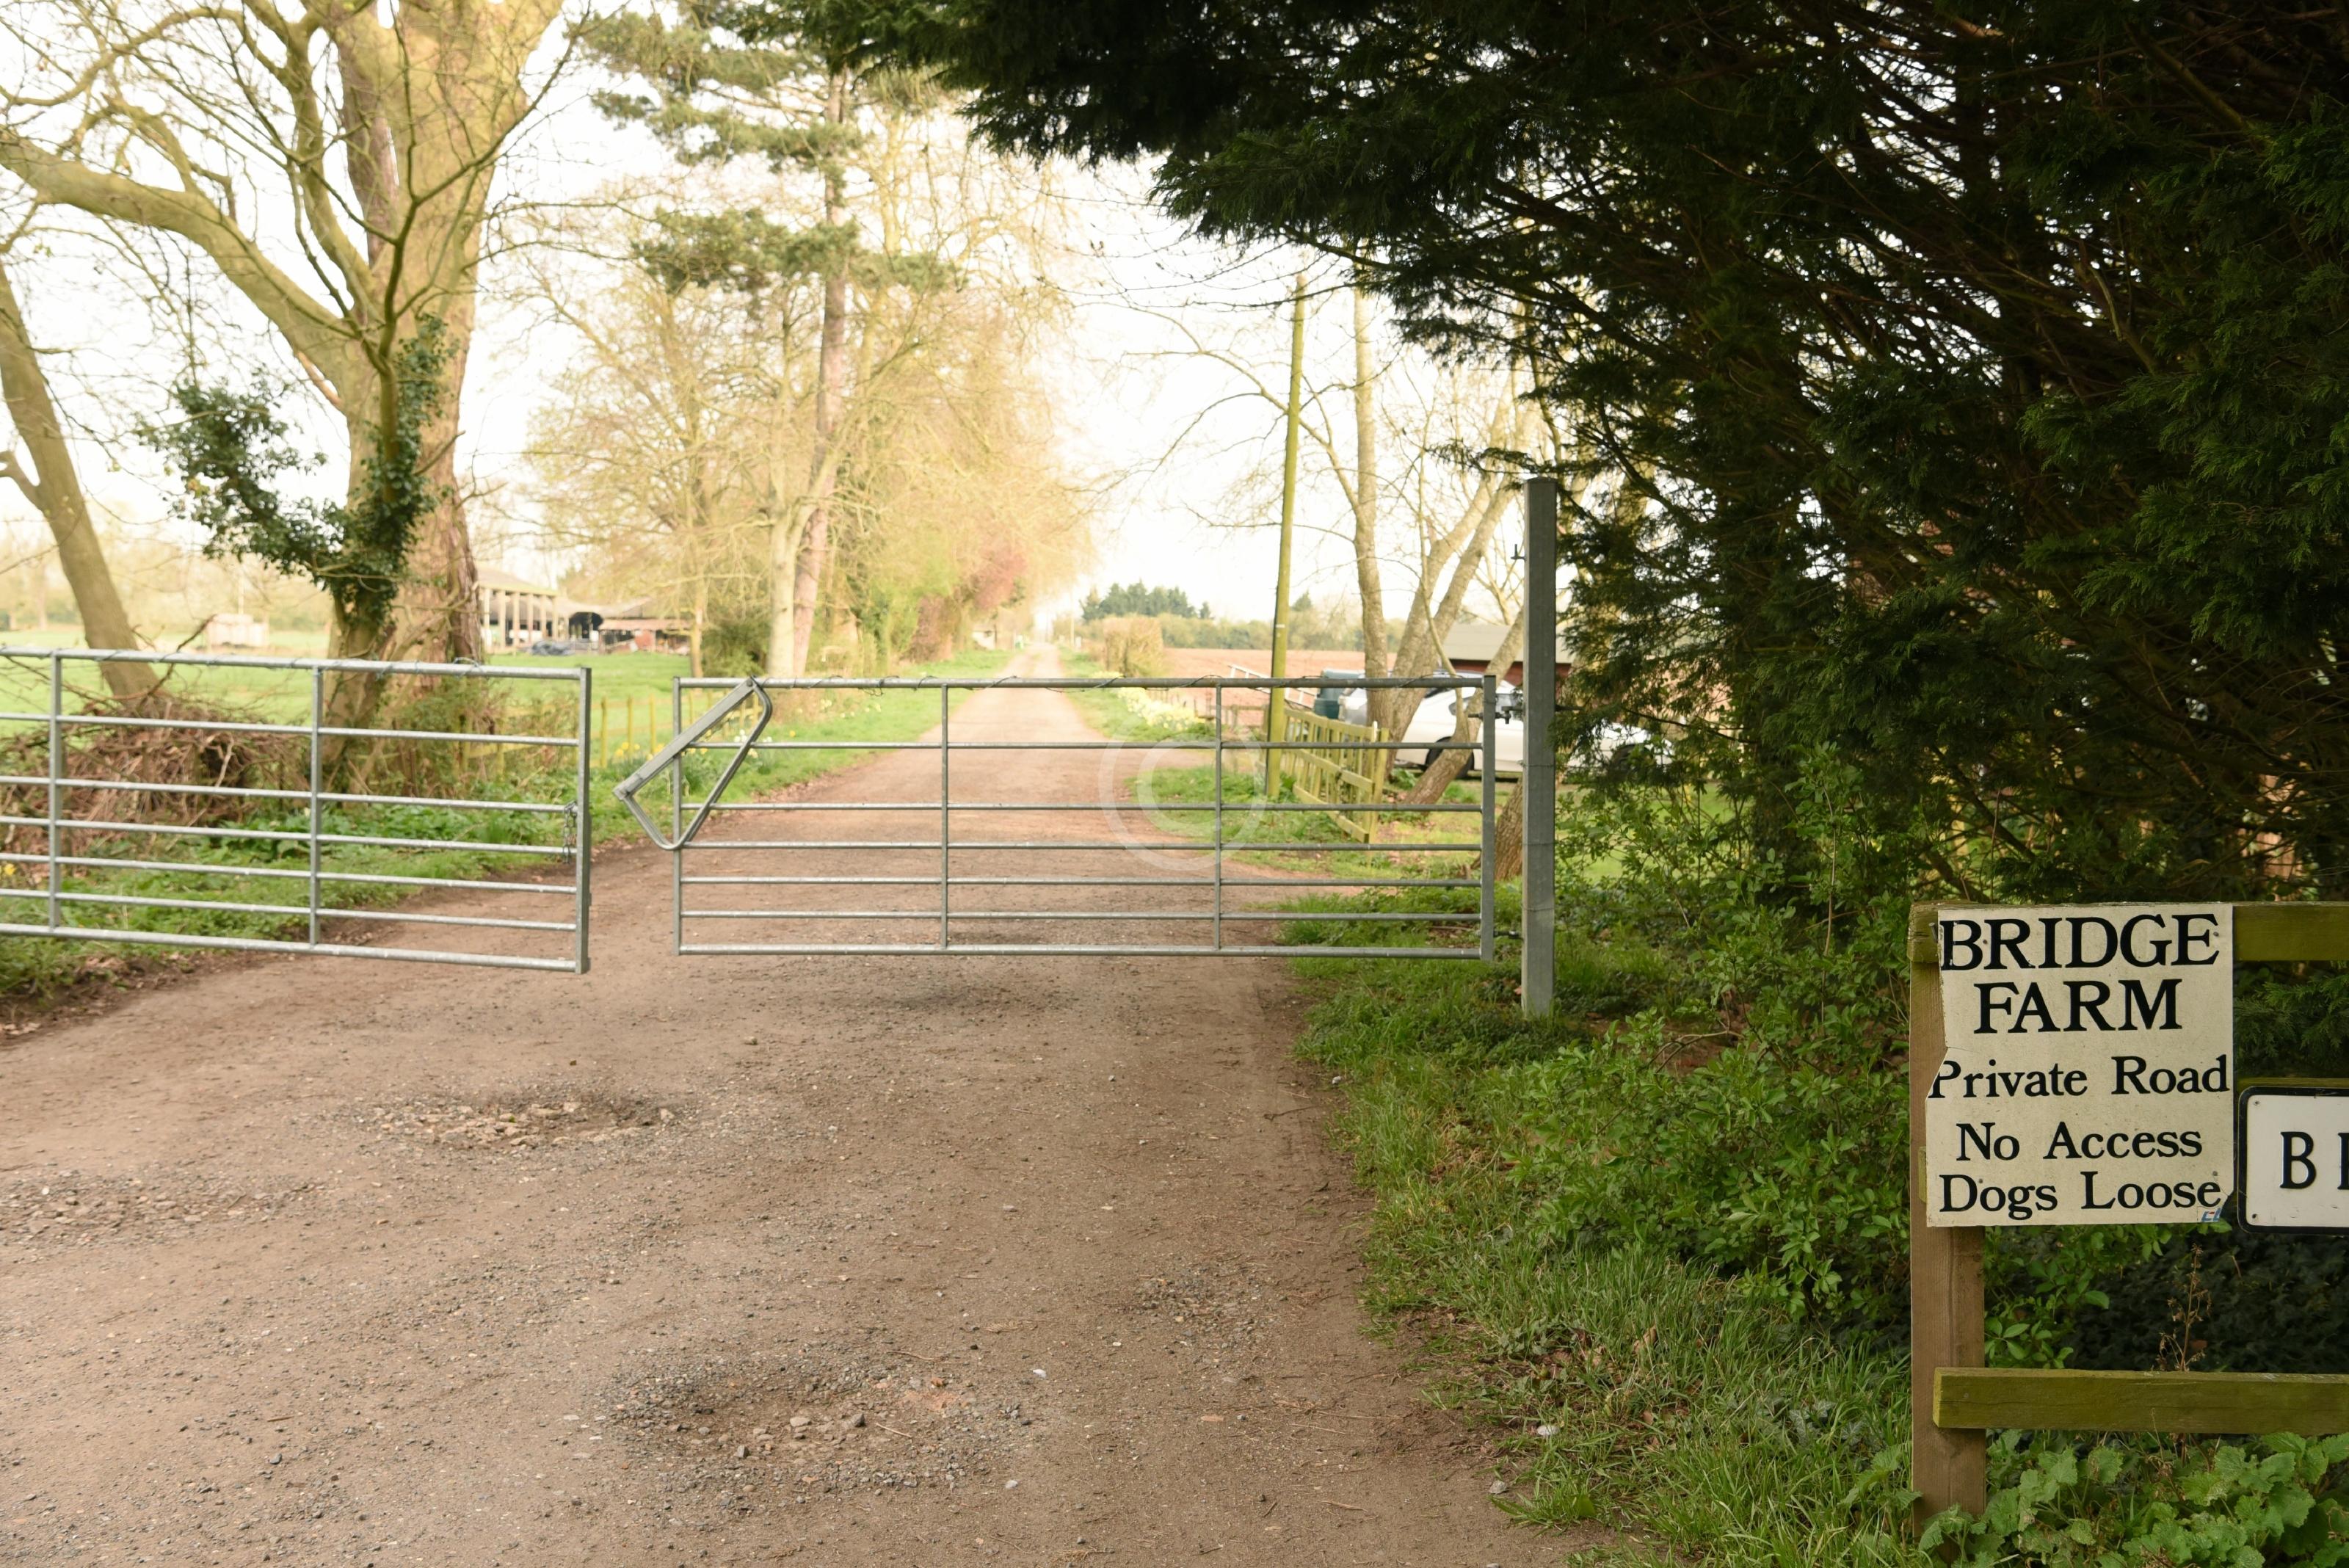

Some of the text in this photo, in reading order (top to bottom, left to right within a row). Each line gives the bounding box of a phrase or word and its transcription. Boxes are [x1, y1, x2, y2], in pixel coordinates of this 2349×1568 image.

[1939, 913, 2220, 971] BRIDGE
[1973, 979, 2183, 1034] FARM
[1928, 1053, 2231, 1099] Private Road
[1956, 1121, 2203, 1161] No Access
[2279, 1131, 2349, 1191] B
[1939, 1171, 2221, 1221] Dogs Loose
